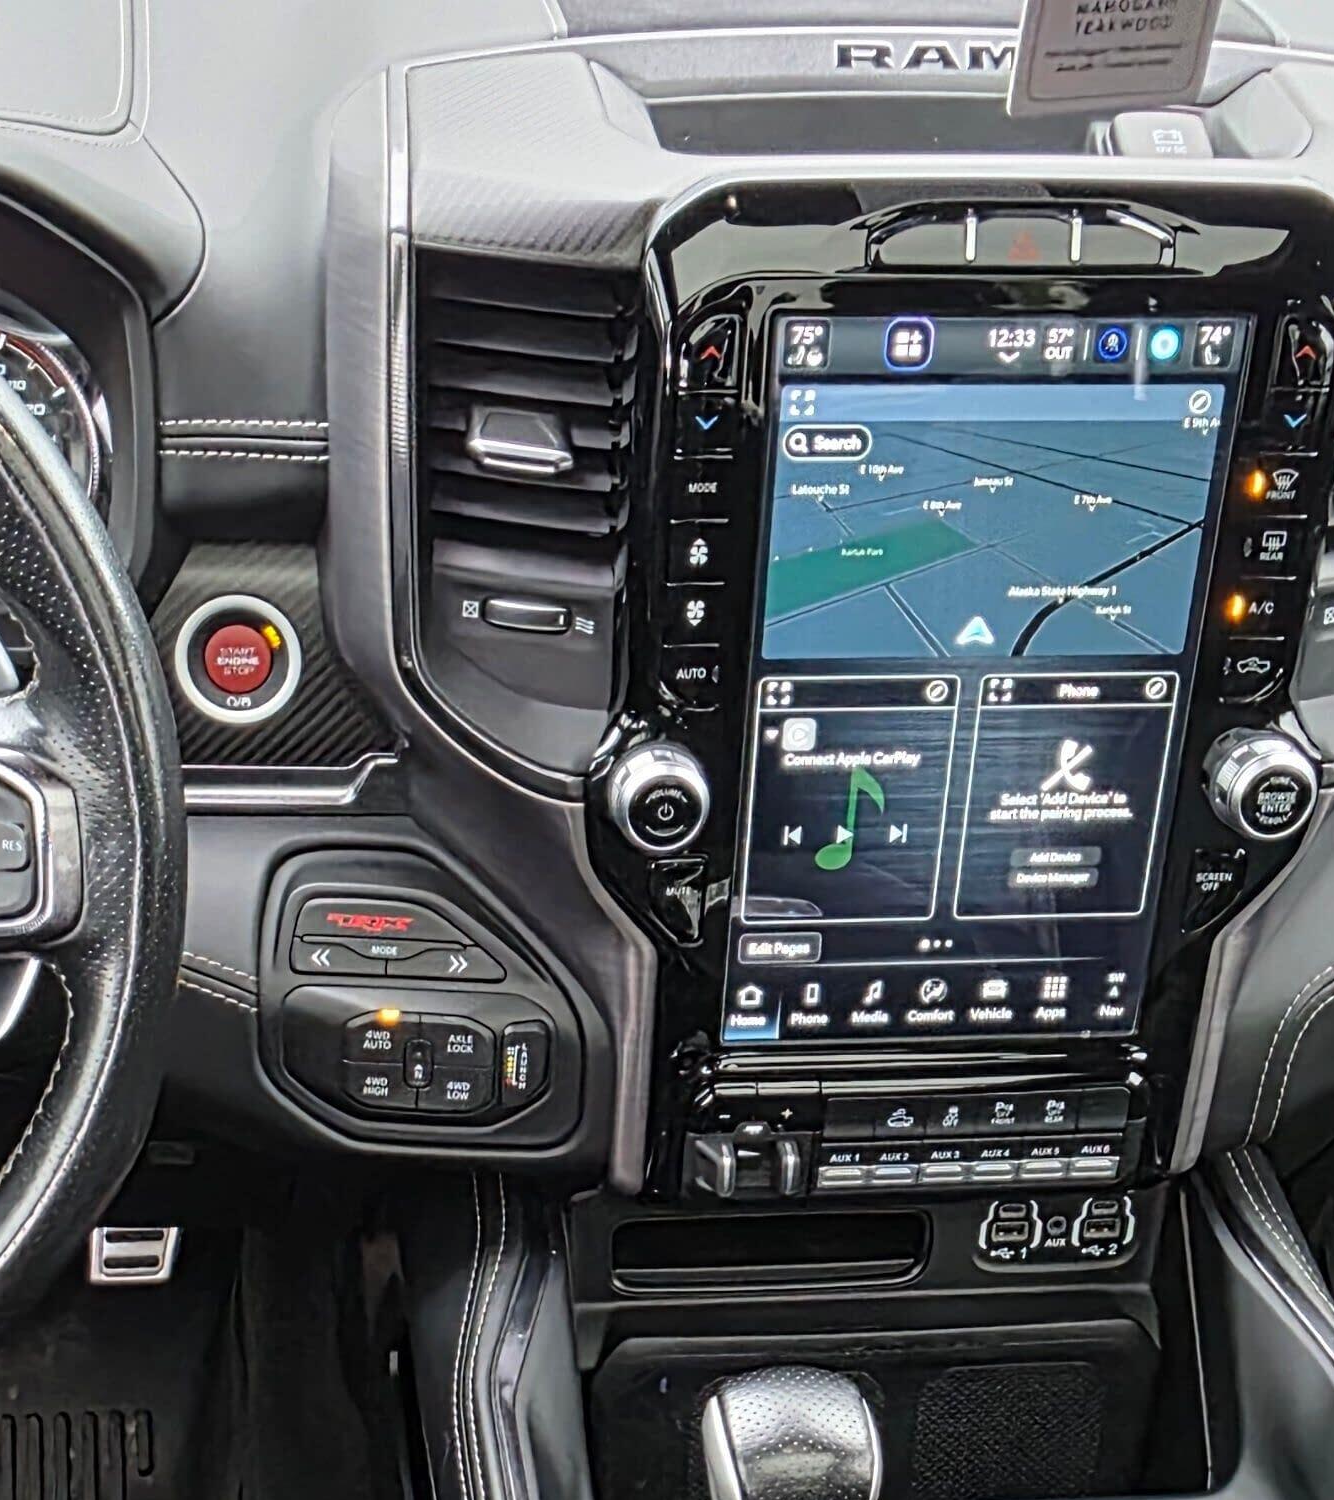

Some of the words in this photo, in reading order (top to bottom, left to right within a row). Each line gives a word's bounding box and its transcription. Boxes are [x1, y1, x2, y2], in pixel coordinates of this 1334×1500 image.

[834, 40, 1016, 71] RAM
[989, 328, 1036, 347] 12:33
[1045, 346, 1074, 360] OUT
[814, 435, 862, 451] Search
[688, 482, 718, 493] MODE
[791, 484, 837, 496] Latouche
[1265, 490, 1296, 500] FRONT
[1259, 552, 1283, 561] REAR
[1008, 586, 1040, 597] Alaska
[1042, 586, 1066, 597] State
[1067, 586, 1111, 599] Highway
[1248, 602, 1274, 615] A/C
[217, 657, 259, 666] ENGINE
[676, 668, 706, 680] AUTO
[1059, 683, 1100, 698] Phone
[784, 753, 835, 767] Connect
[836, 751, 872, 768] Apple
[872, 750, 921, 767] CarPlay
[1000, 793, 1038, 806] Select
[1114, 793, 1127, 804] to
[1258, 791, 1298, 804] BROWSE
[1261, 803, 1292, 813] ENTER
[989, 808, 1018, 820] start
[1020, 808, 1040, 820] the
[1041, 807, 1082, 822] pairing
[1083, 807, 1134, 822] process.
[2, 839, 23, 852] RES
[1029, 852, 1048, 863] Add
[1050, 852, 1082, 863] Device
[1016, 873, 1047, 884] Device
[1048, 872, 1091, 885] Manager
[1195, 872, 1233, 883] SCREEN
[1201, 882, 1219, 891] OFF
[327, 912, 415, 933] TRX
[371, 945, 397, 956] MODE
[748, 943, 772, 956] Edit
[773, 942, 810, 957] Pages
[852, 1010, 889, 1023] Media
[907, 1009, 955, 1023] Comfort
[970, 1007, 1013, 1020] Vehicle
[1035, 1006, 1067, 1021] Apps
[1099, 1005, 1125, 1017] Nav
[730, 1014, 766, 1027] Home
[791, 1012, 829, 1025] Phone
[365, 1030, 390, 1040] 4WD
[449, 1034, 474, 1044] AXLE
[363, 1040, 392, 1050] AUTO
[447, 1043, 473, 1053] LOCK
[365, 1077, 388, 1086] 4WD
[446, 1081, 470, 1091] 4WD
[363, 1086, 388, 1097] HIGH
[446, 1090, 469, 1100] LOW
[930, 1150, 953, 1159] AUX
[981, 1149, 1002, 1158] AUX
[1031, 1147, 1050, 1156] AUX
[1081, 1145, 1103, 1154] AUX
[830, 1153, 852, 1163] AUX
[879, 1152, 902, 1161] AUX
[1044, 1238, 1067, 1247] AUX
[1020, 1246, 1027, 1259] 1
[1108, 1243, 1118, 1255] 2
